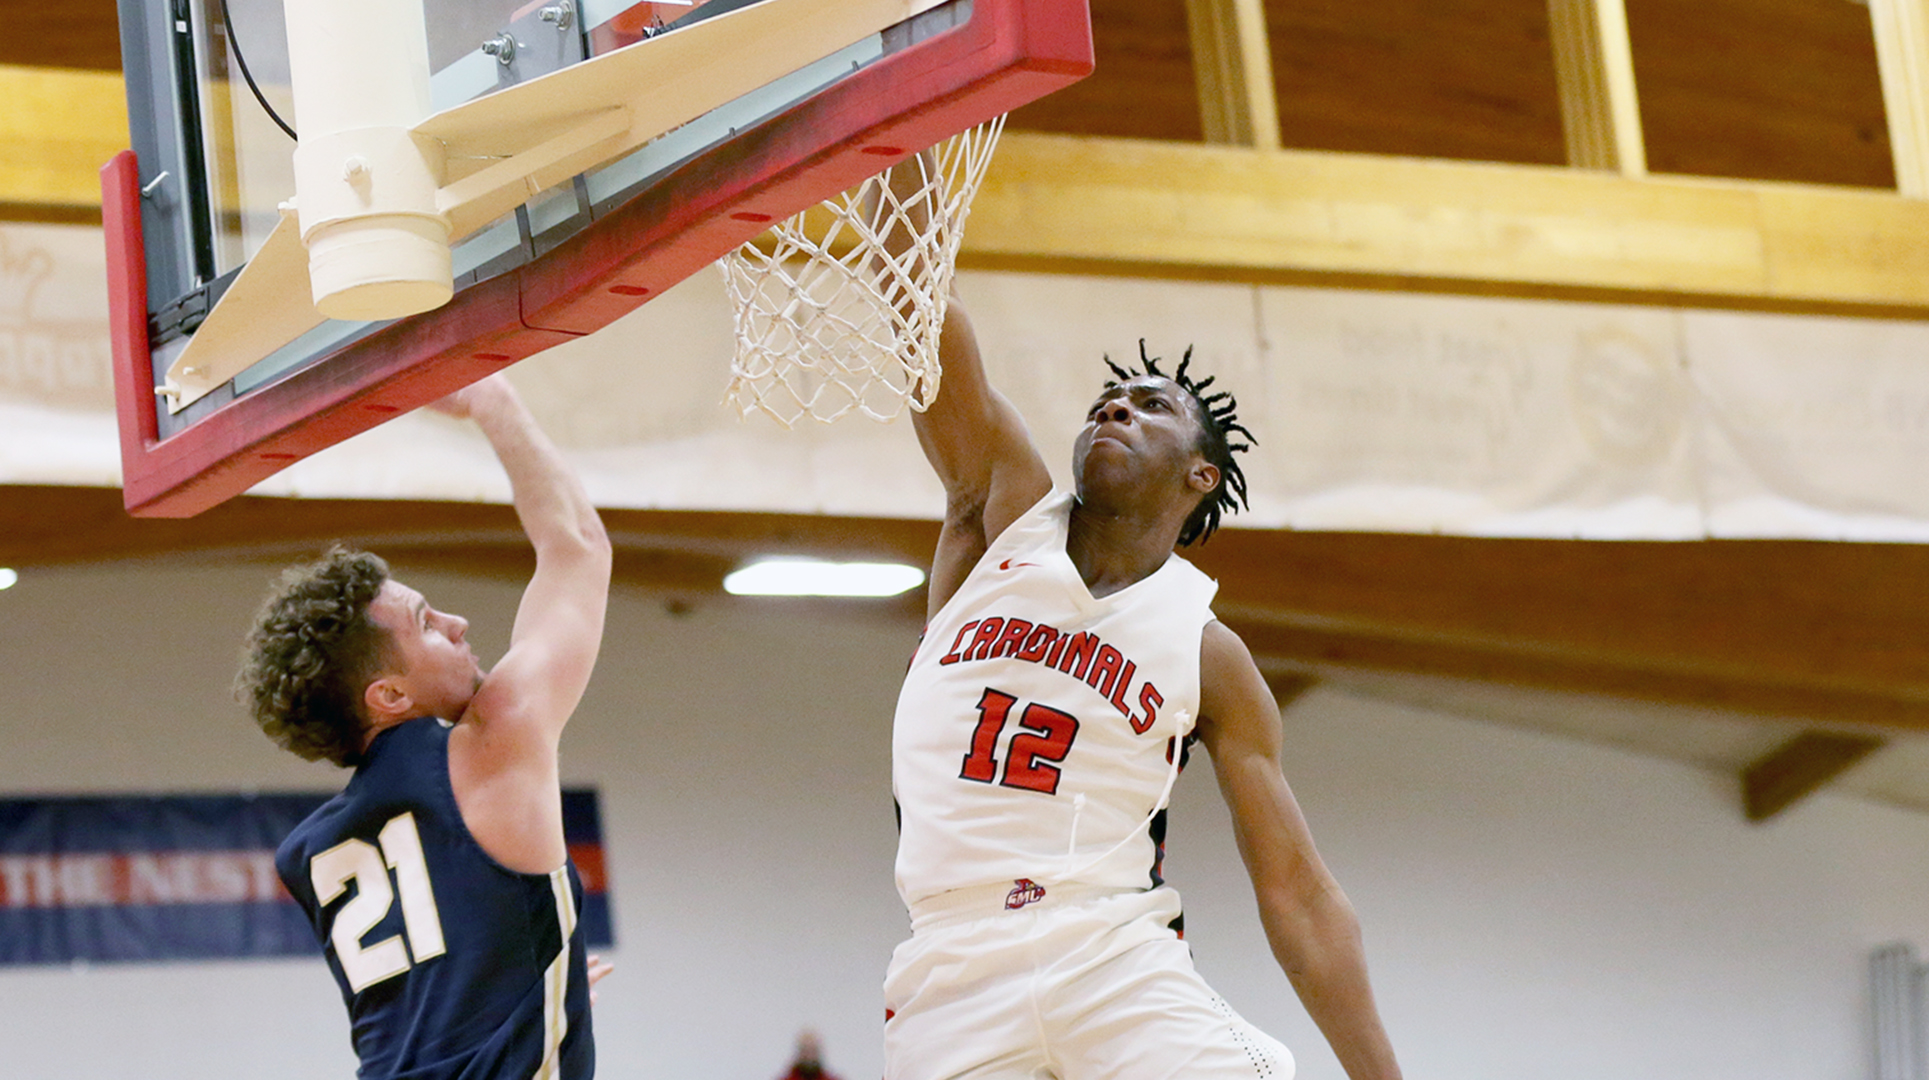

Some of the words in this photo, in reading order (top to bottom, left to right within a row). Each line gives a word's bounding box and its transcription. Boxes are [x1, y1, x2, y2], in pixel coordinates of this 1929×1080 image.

[940, 617, 1164, 735] CARDINALS
[958, 687, 1080, 795] 12
[1, 855, 108, 905] THE
[310, 811, 446, 994] 21
